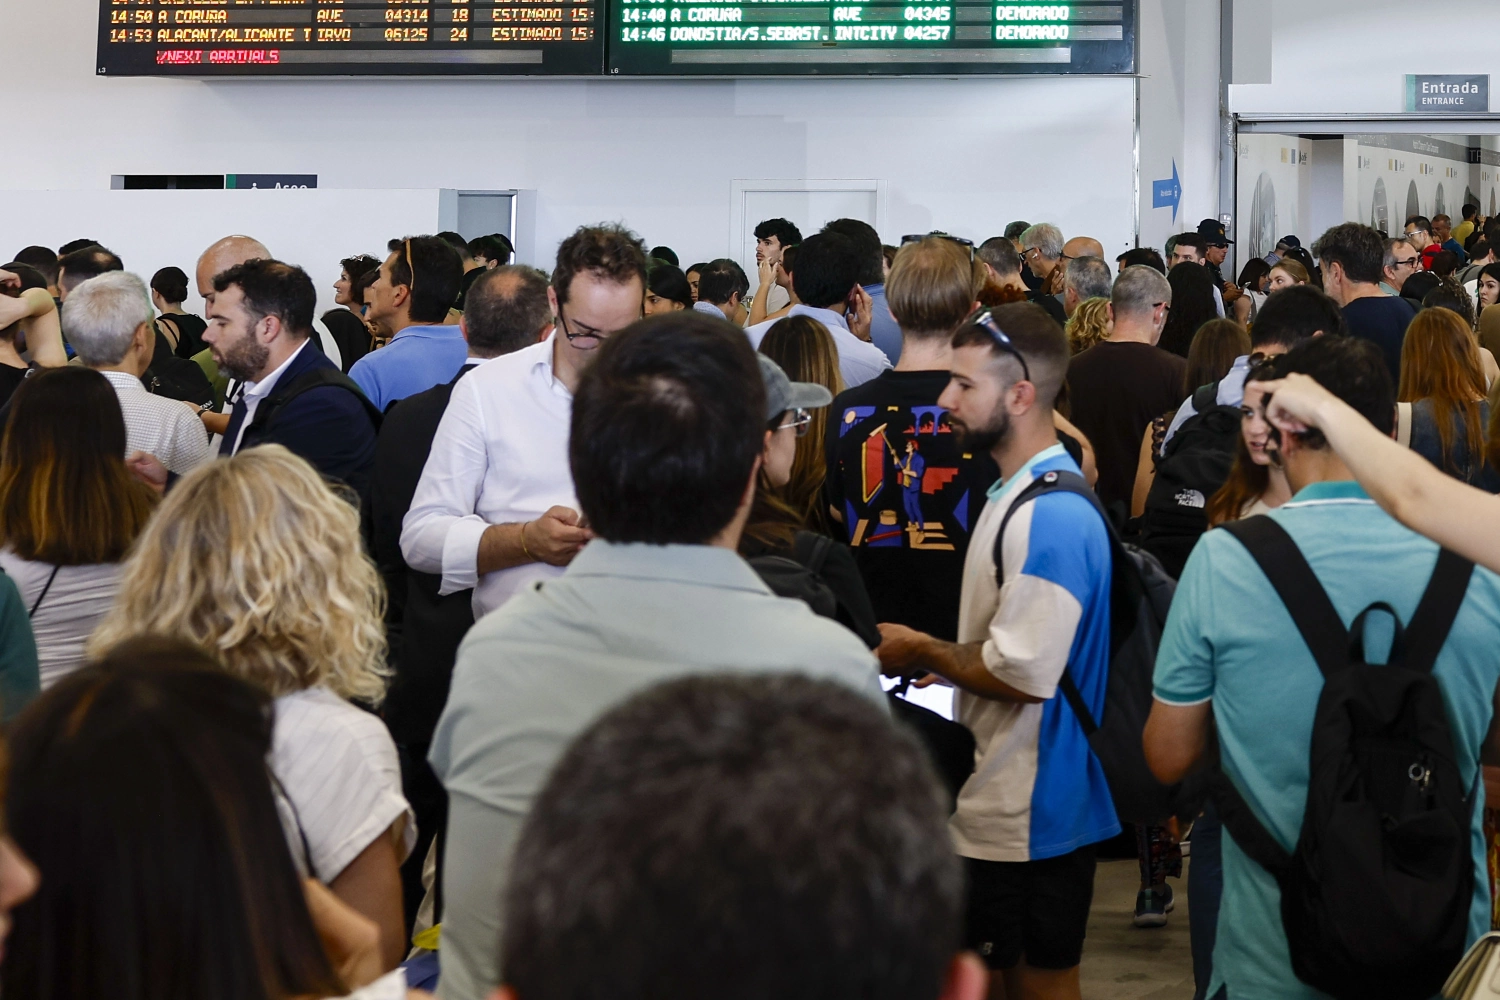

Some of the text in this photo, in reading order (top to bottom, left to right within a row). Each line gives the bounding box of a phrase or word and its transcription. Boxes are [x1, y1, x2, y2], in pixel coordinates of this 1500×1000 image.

[111, 10, 153, 24] 14:50
[158, 10, 228, 24] A CORUÑA
[316, 9, 428, 22] AVE 04314
[452, 8, 468, 22] 18
[492, 8, 595, 22] ESTIMADO 15:
[622, 8, 666, 22] 14:40
[670, 7, 742, 22] A CORUÑA
[833, 6, 951, 21] AVE 04345
[996, 6, 1070, 20] DEMORADO
[110, 29, 152, 43] 14:53
[157, 28, 312, 42] ALACANT/ALICANTE T
[318, 28, 351, 42] IRYO
[450, 28, 468, 42] 24
[492, 27, 594, 41] ESTIMADO 15:
[622, 27, 666, 42] 14:46
[670, 26, 829, 41] DONOSTIA/S.SEBAST.
[834, 26, 950, 40] INTCITY 04257
[996, 25, 1070, 40] DEMORADO
[156, 50, 280, 65] /NEXT ARRIVALS
[1422, 82, 1478, 94] Entrada
[1422, 97, 1464, 105] ENTRANCE
